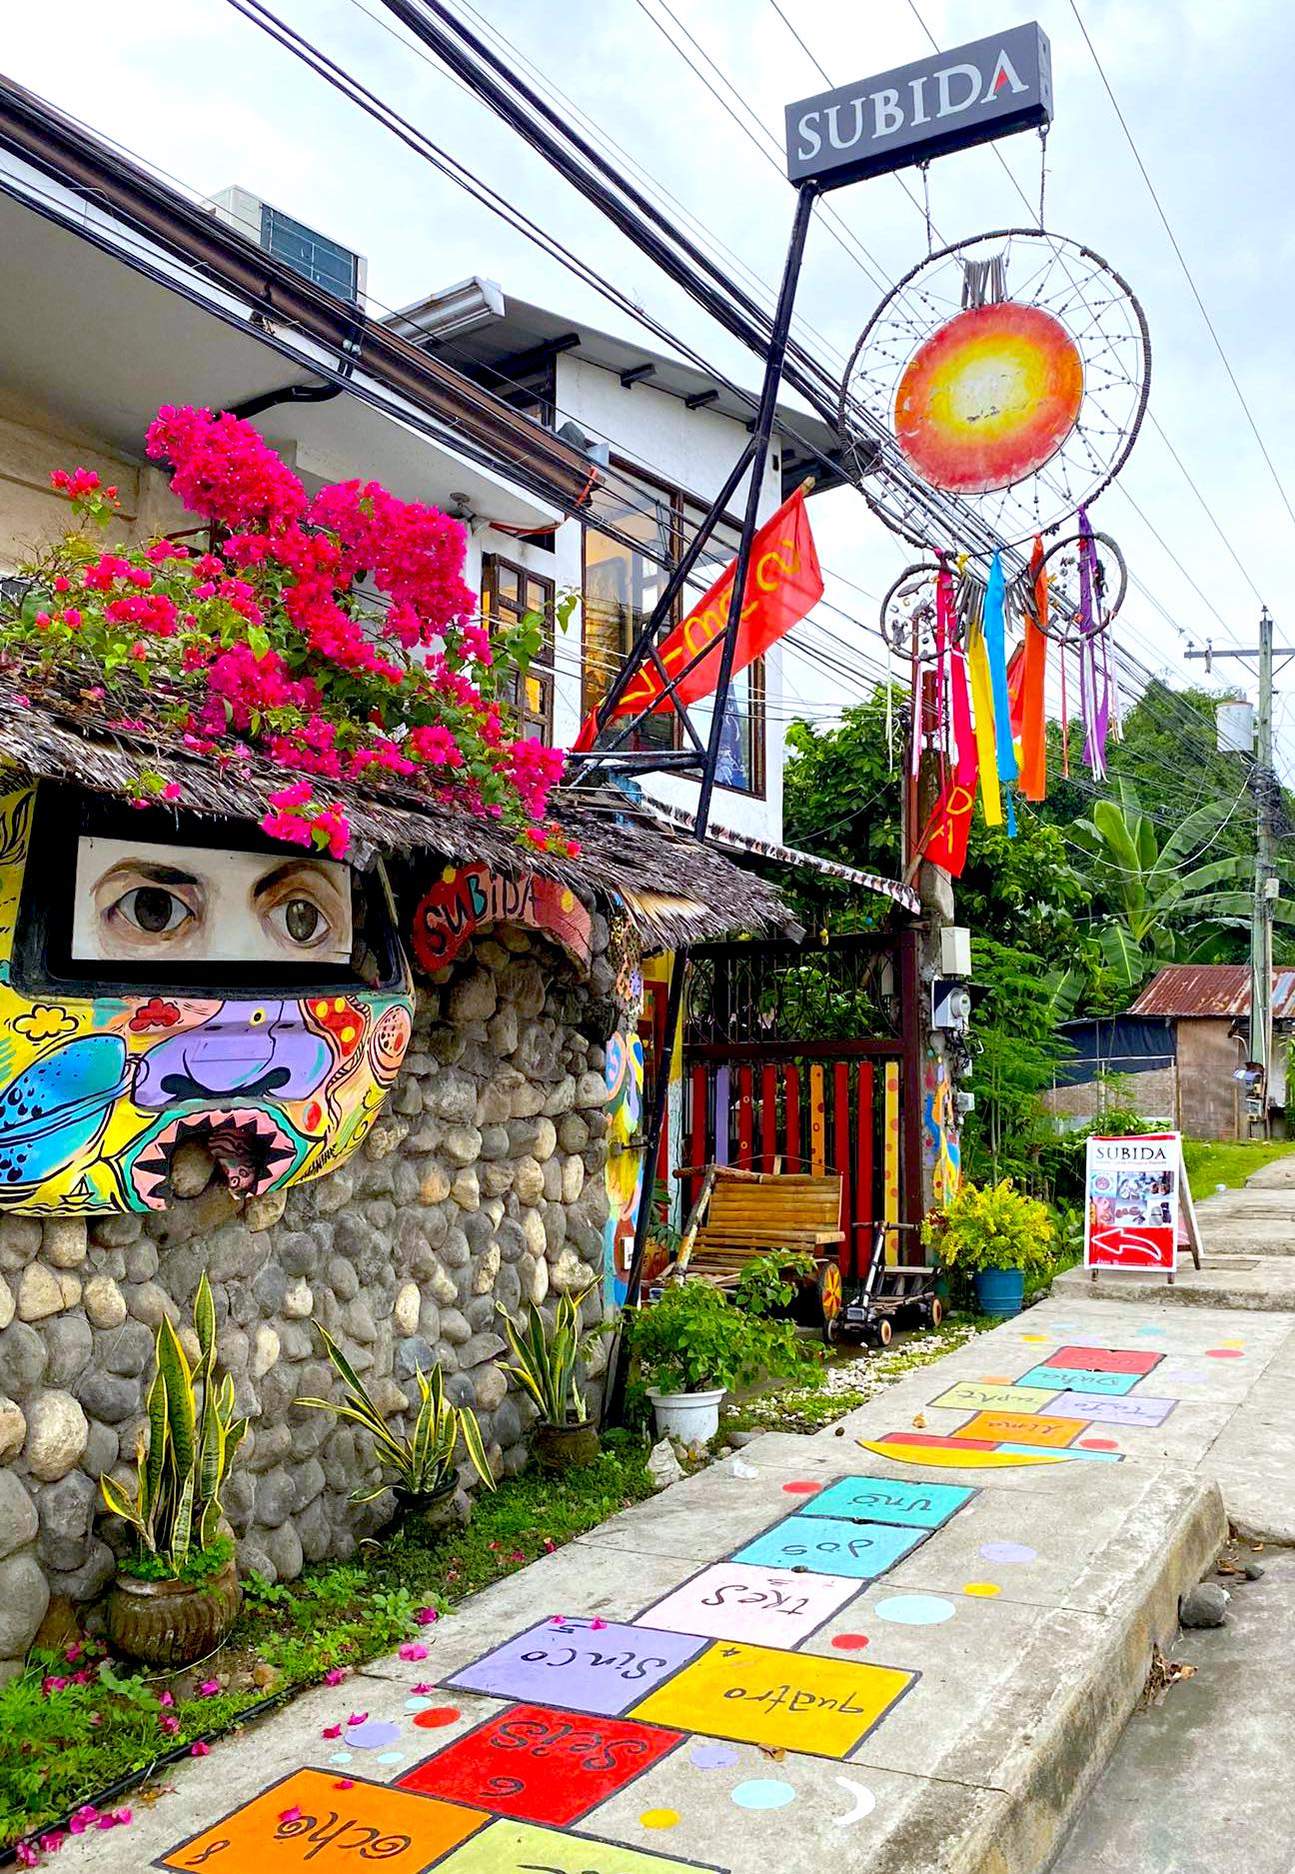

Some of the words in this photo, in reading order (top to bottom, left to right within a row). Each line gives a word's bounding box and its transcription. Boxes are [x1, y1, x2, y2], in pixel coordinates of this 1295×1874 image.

[798, 49, 1029, 160] SUBIDA
[1096, 1147, 1167, 1160] SUBIDA
[520, 1647, 667, 1680] Sinco
[720, 1646, 742, 1659] 4
[490, 1720, 648, 1771] Seis
[480, 1776, 526, 1798] 6
[185, 1840, 231, 1865] 8
